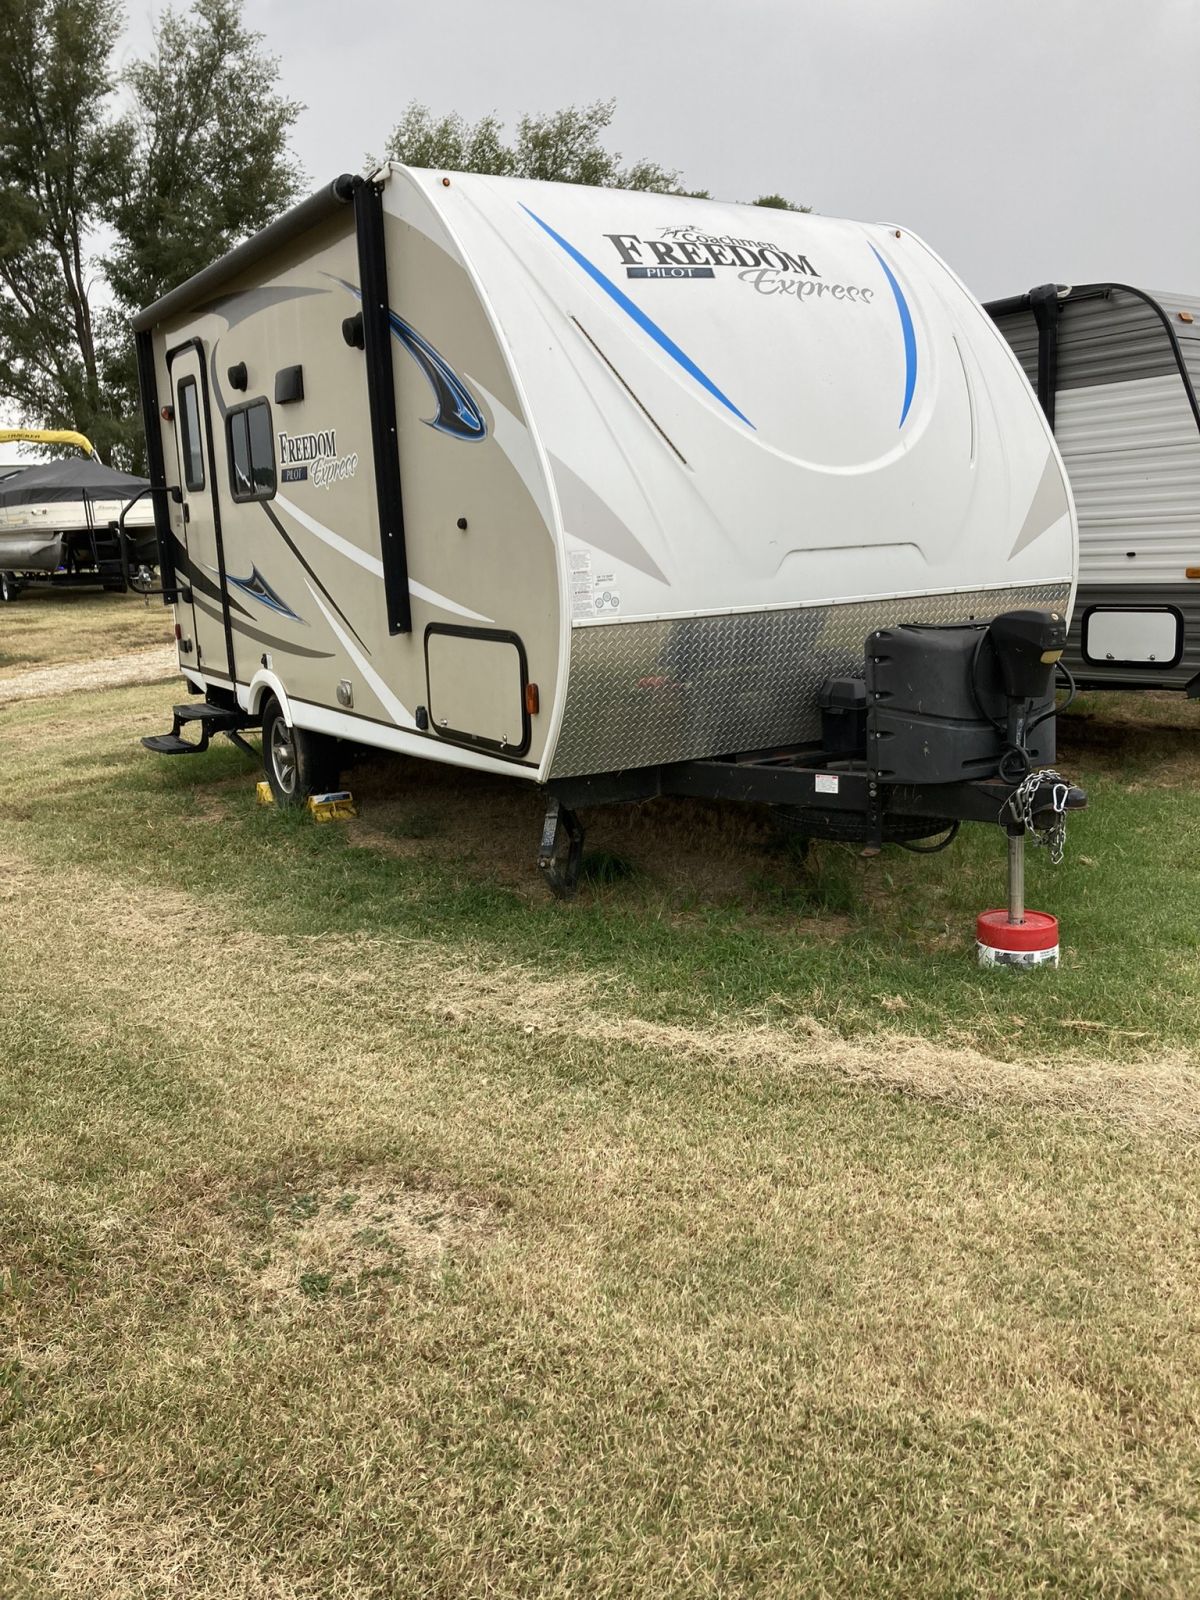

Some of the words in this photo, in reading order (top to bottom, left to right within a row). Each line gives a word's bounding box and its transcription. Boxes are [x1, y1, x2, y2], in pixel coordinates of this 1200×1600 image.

[602, 234, 821, 277] FREEDOM
[681, 232, 780, 251] Coachmen
[646, 267, 695, 278] PILOT
[737, 268, 874, 304] Express
[278, 431, 336, 463] FREEDOM
[286, 468, 302, 480] PILOT
[311, 455, 357, 488] Express
